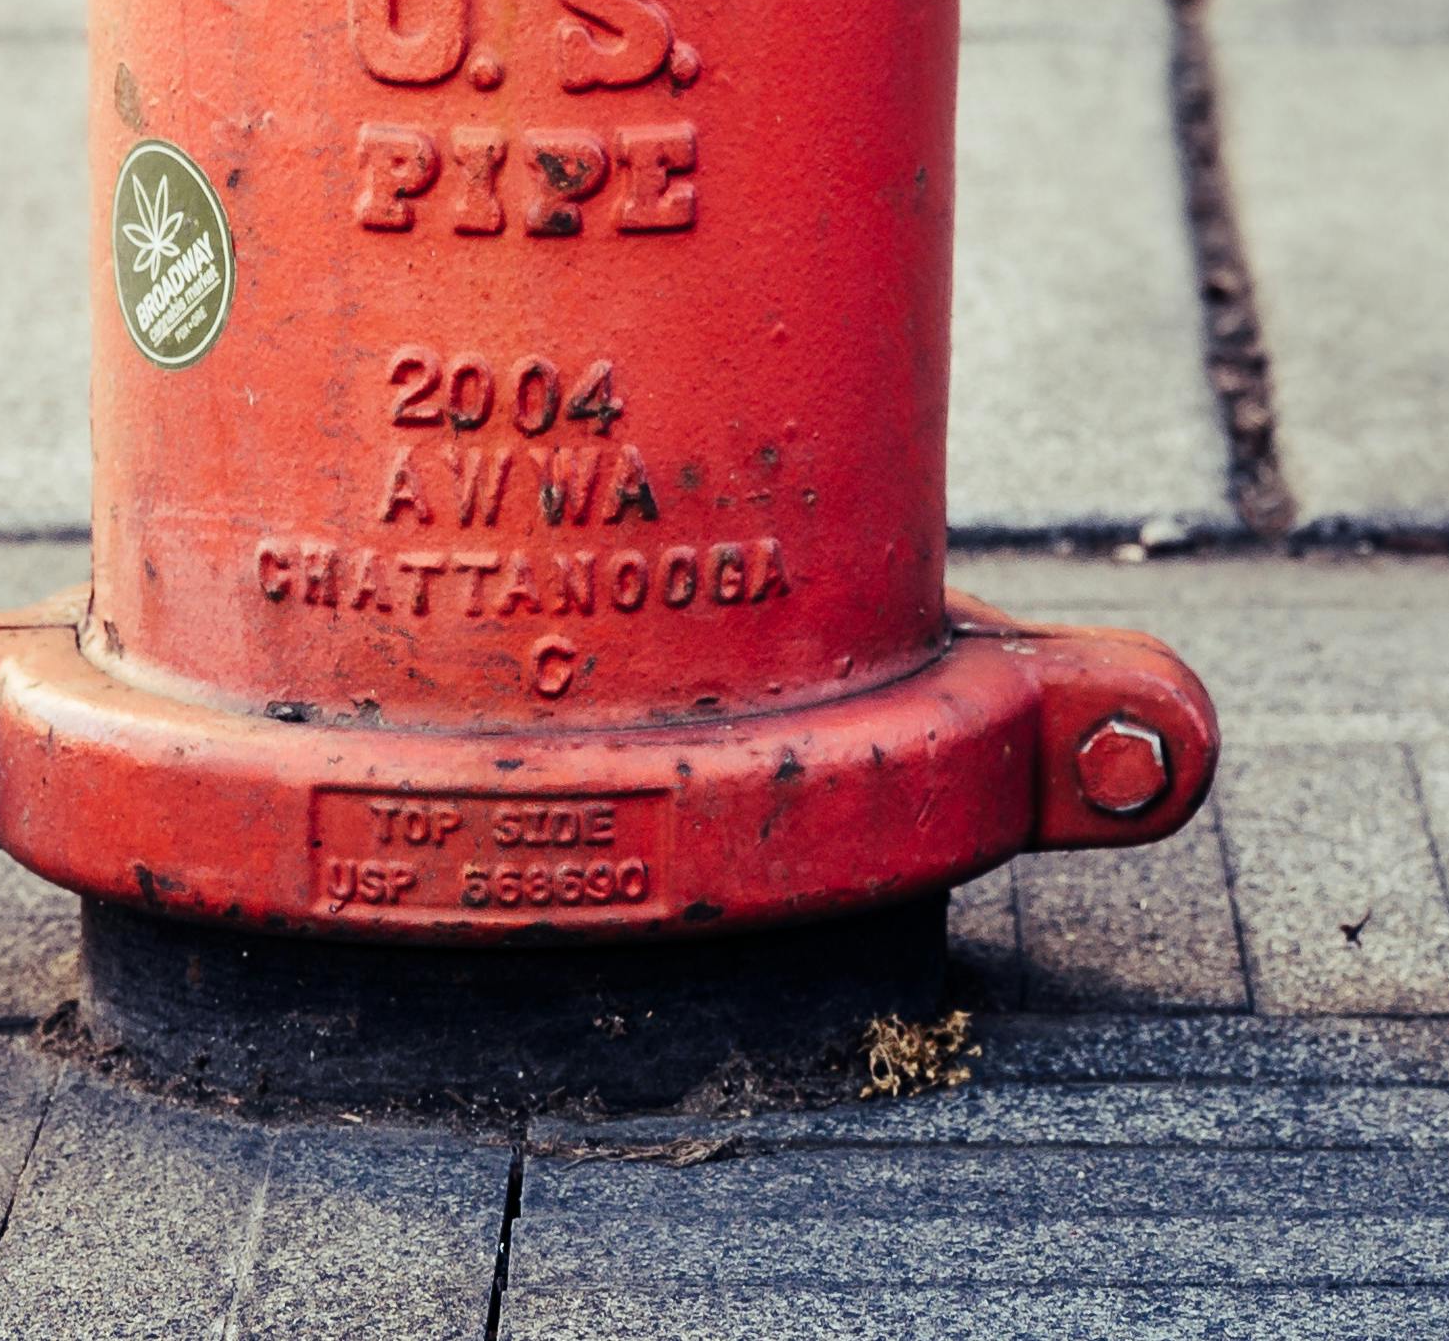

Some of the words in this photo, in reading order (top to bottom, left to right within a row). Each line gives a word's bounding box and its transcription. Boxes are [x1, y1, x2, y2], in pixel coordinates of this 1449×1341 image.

[355, 122, 697, 238] PIPE
[135, 230, 215, 332] BROADWAY
[149, 296, 187, 343] cannabis
[184, 263, 220, 305] market
[389, 344, 625, 438] 2004
[377, 443, 660, 528] AWWA
[254, 536, 791, 617] CHATTANOOGA
[370, 798, 463, 849] TOP
[493, 800, 616, 849] SIDE
[325, 857, 419, 907] USP
